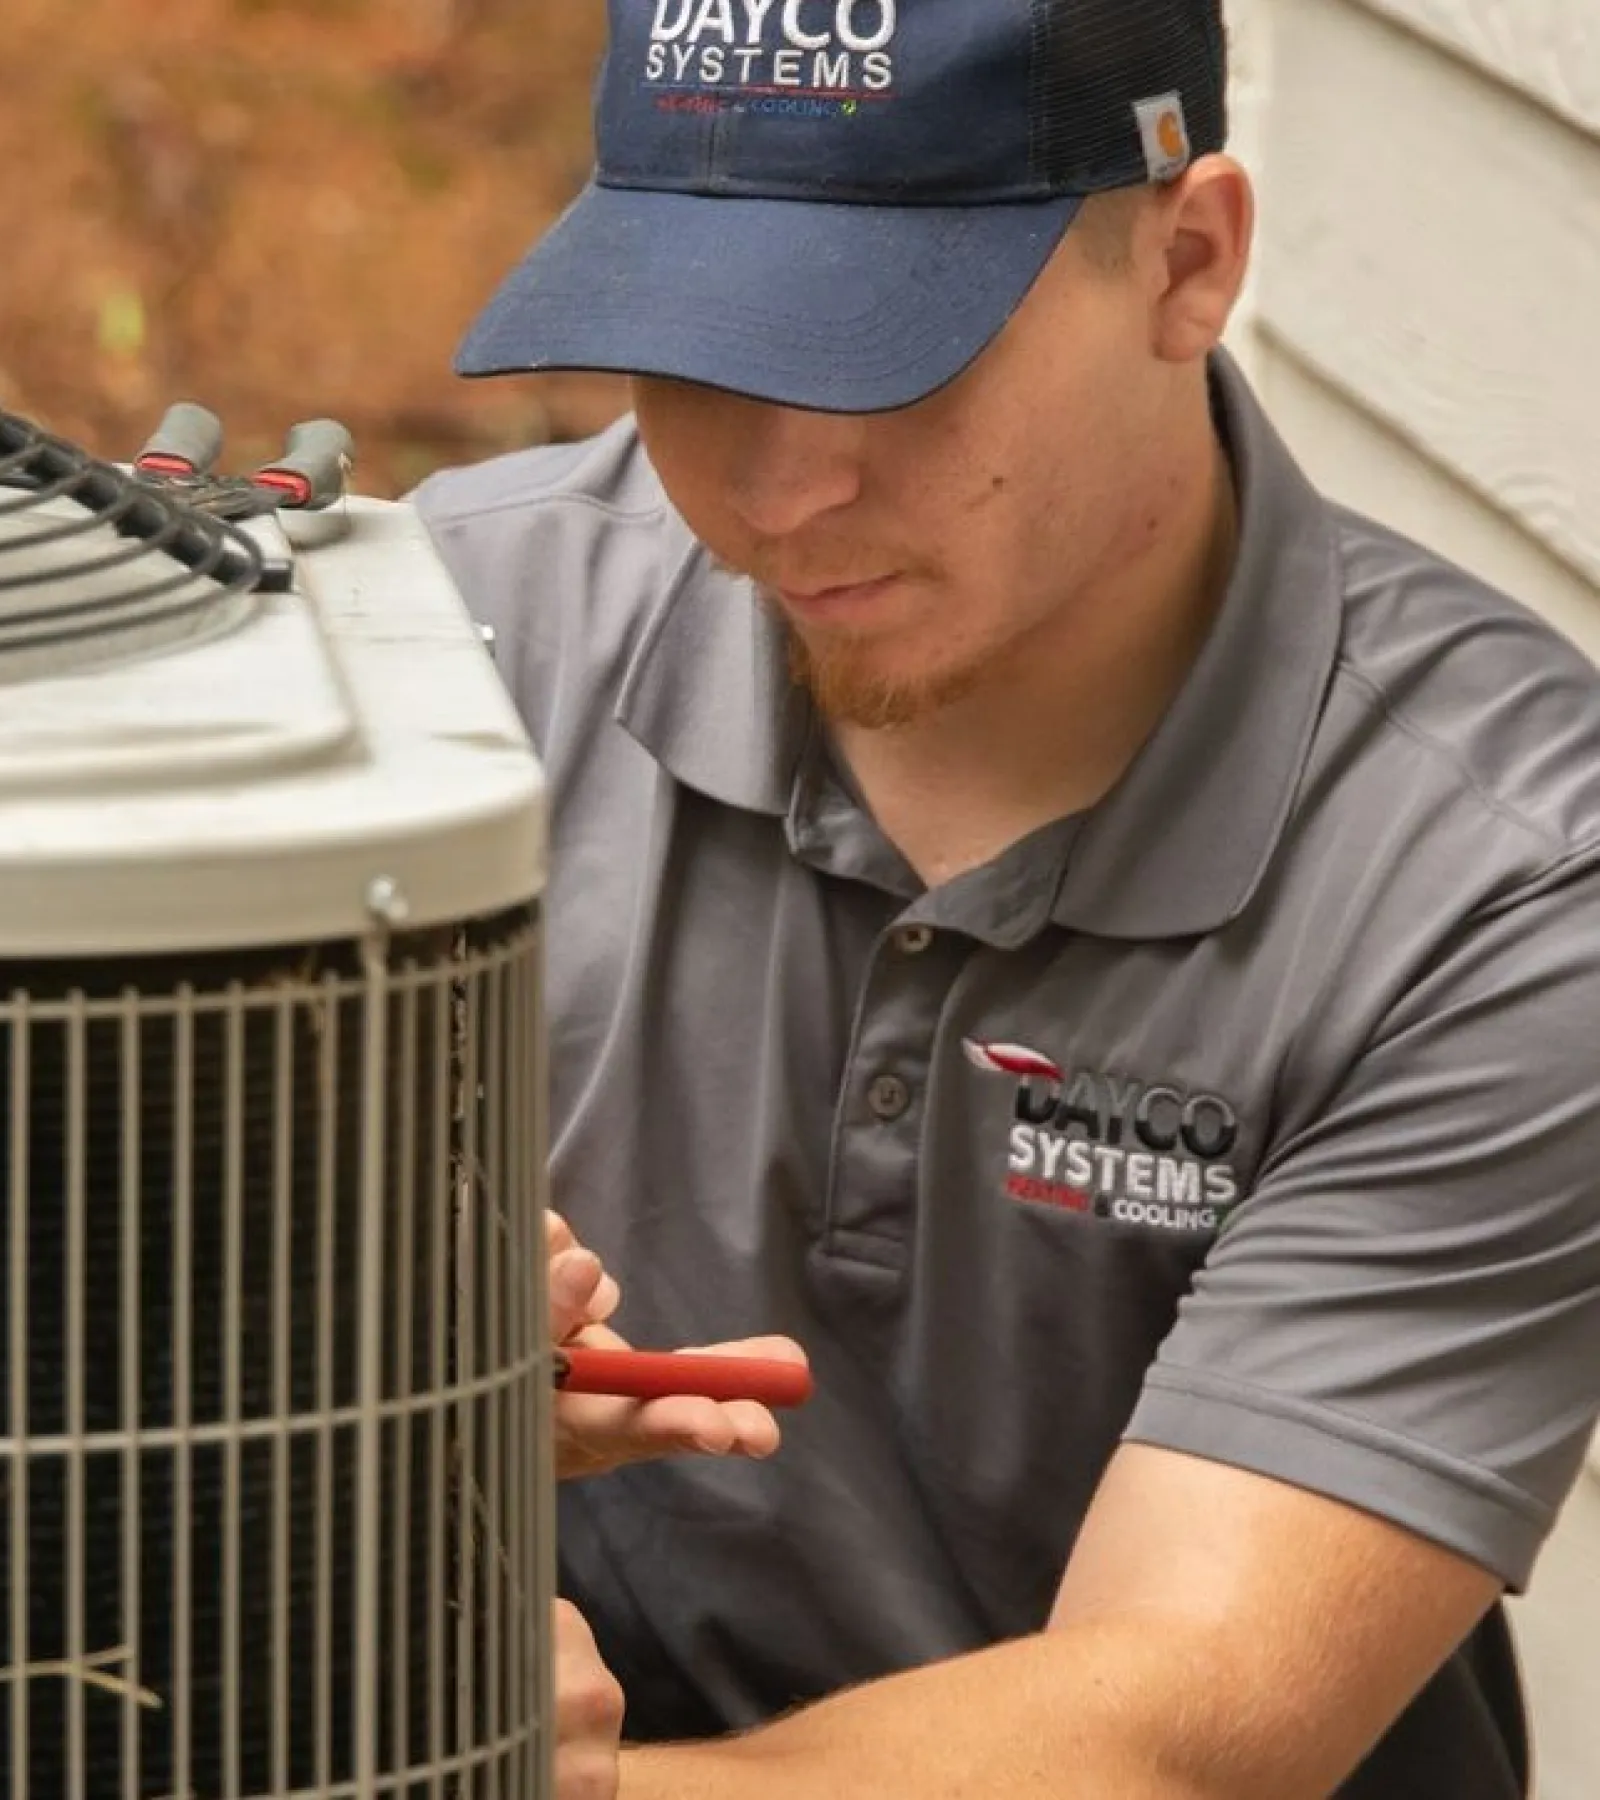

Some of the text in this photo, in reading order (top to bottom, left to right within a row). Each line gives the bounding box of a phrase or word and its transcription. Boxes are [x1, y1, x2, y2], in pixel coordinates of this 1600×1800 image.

[650, 0, 897, 49] DAYCO
[645, 44, 893, 89] SYSTEMS
[1014, 1069, 1238, 1159] DAYCO
[1007, 1123, 1237, 1204] SYSTEMS
[1111, 1199, 1216, 1230] COOLING
